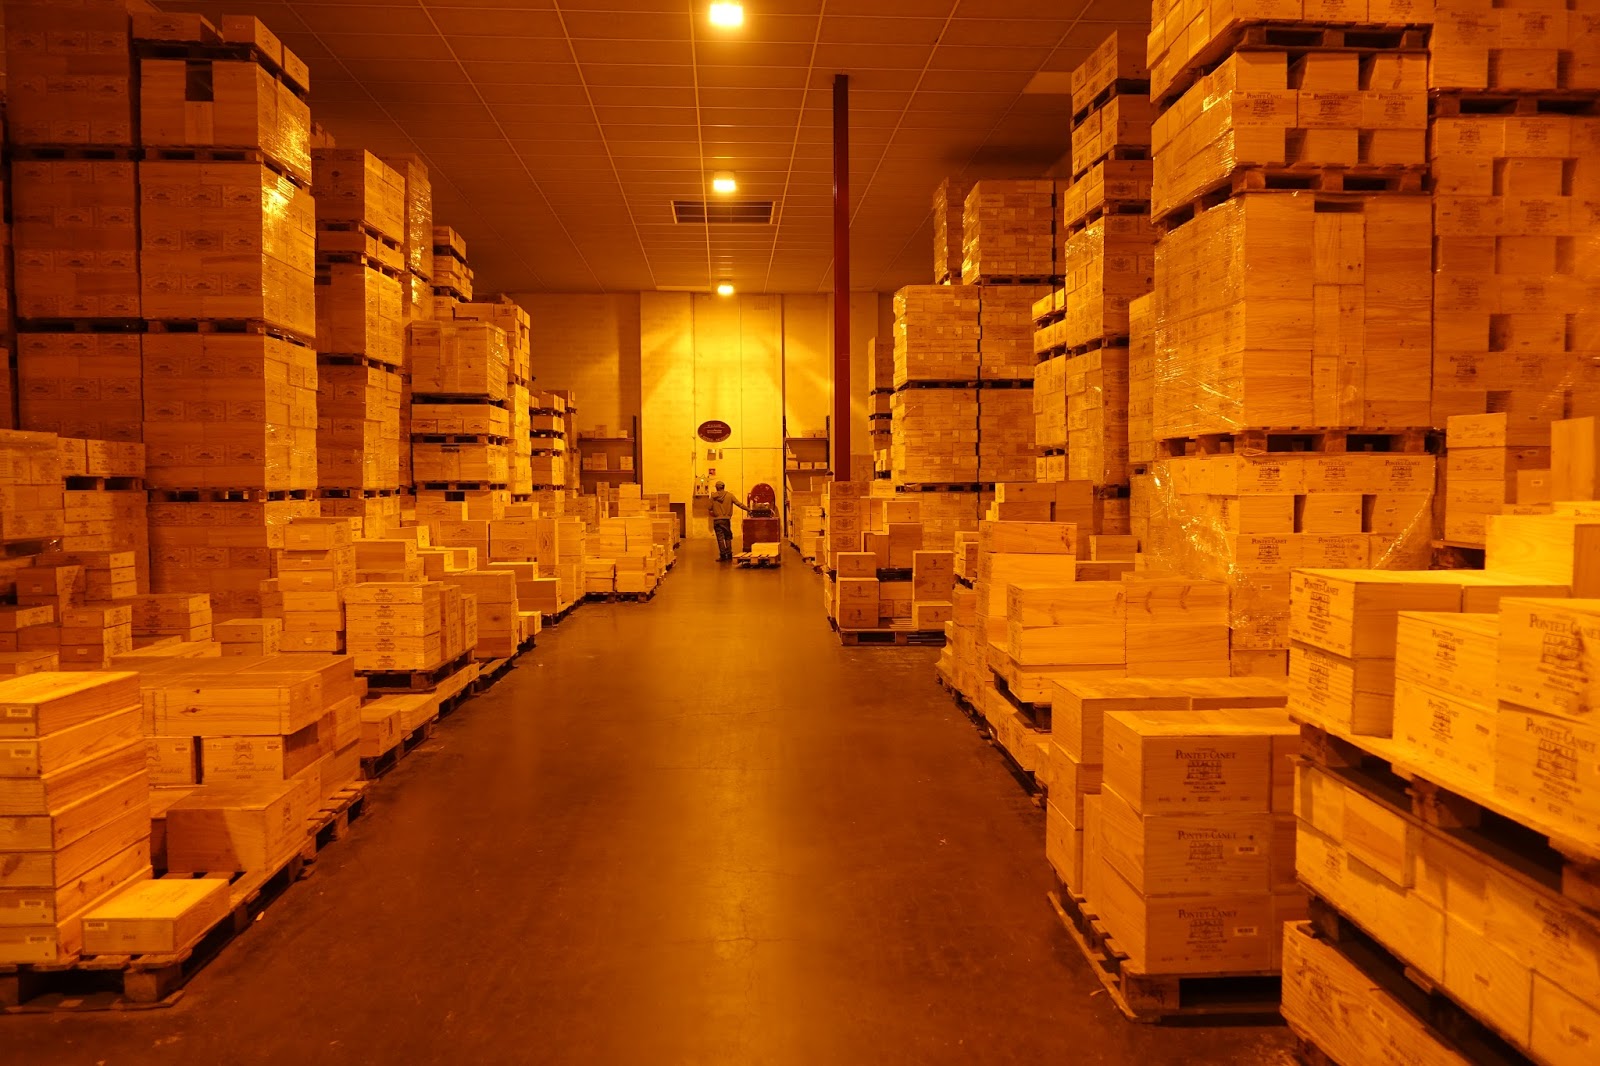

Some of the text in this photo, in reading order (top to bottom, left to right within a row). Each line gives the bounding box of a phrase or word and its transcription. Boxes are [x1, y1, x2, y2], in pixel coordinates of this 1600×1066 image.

[1525, 717, 1596, 753] PONTET-CANET
[1175, 749, 1237, 759] PONTET-CANET
[1178, 830, 1237, 840] PONTET-CANET
[1178, 909, 1237, 919] PONTET-CANET
